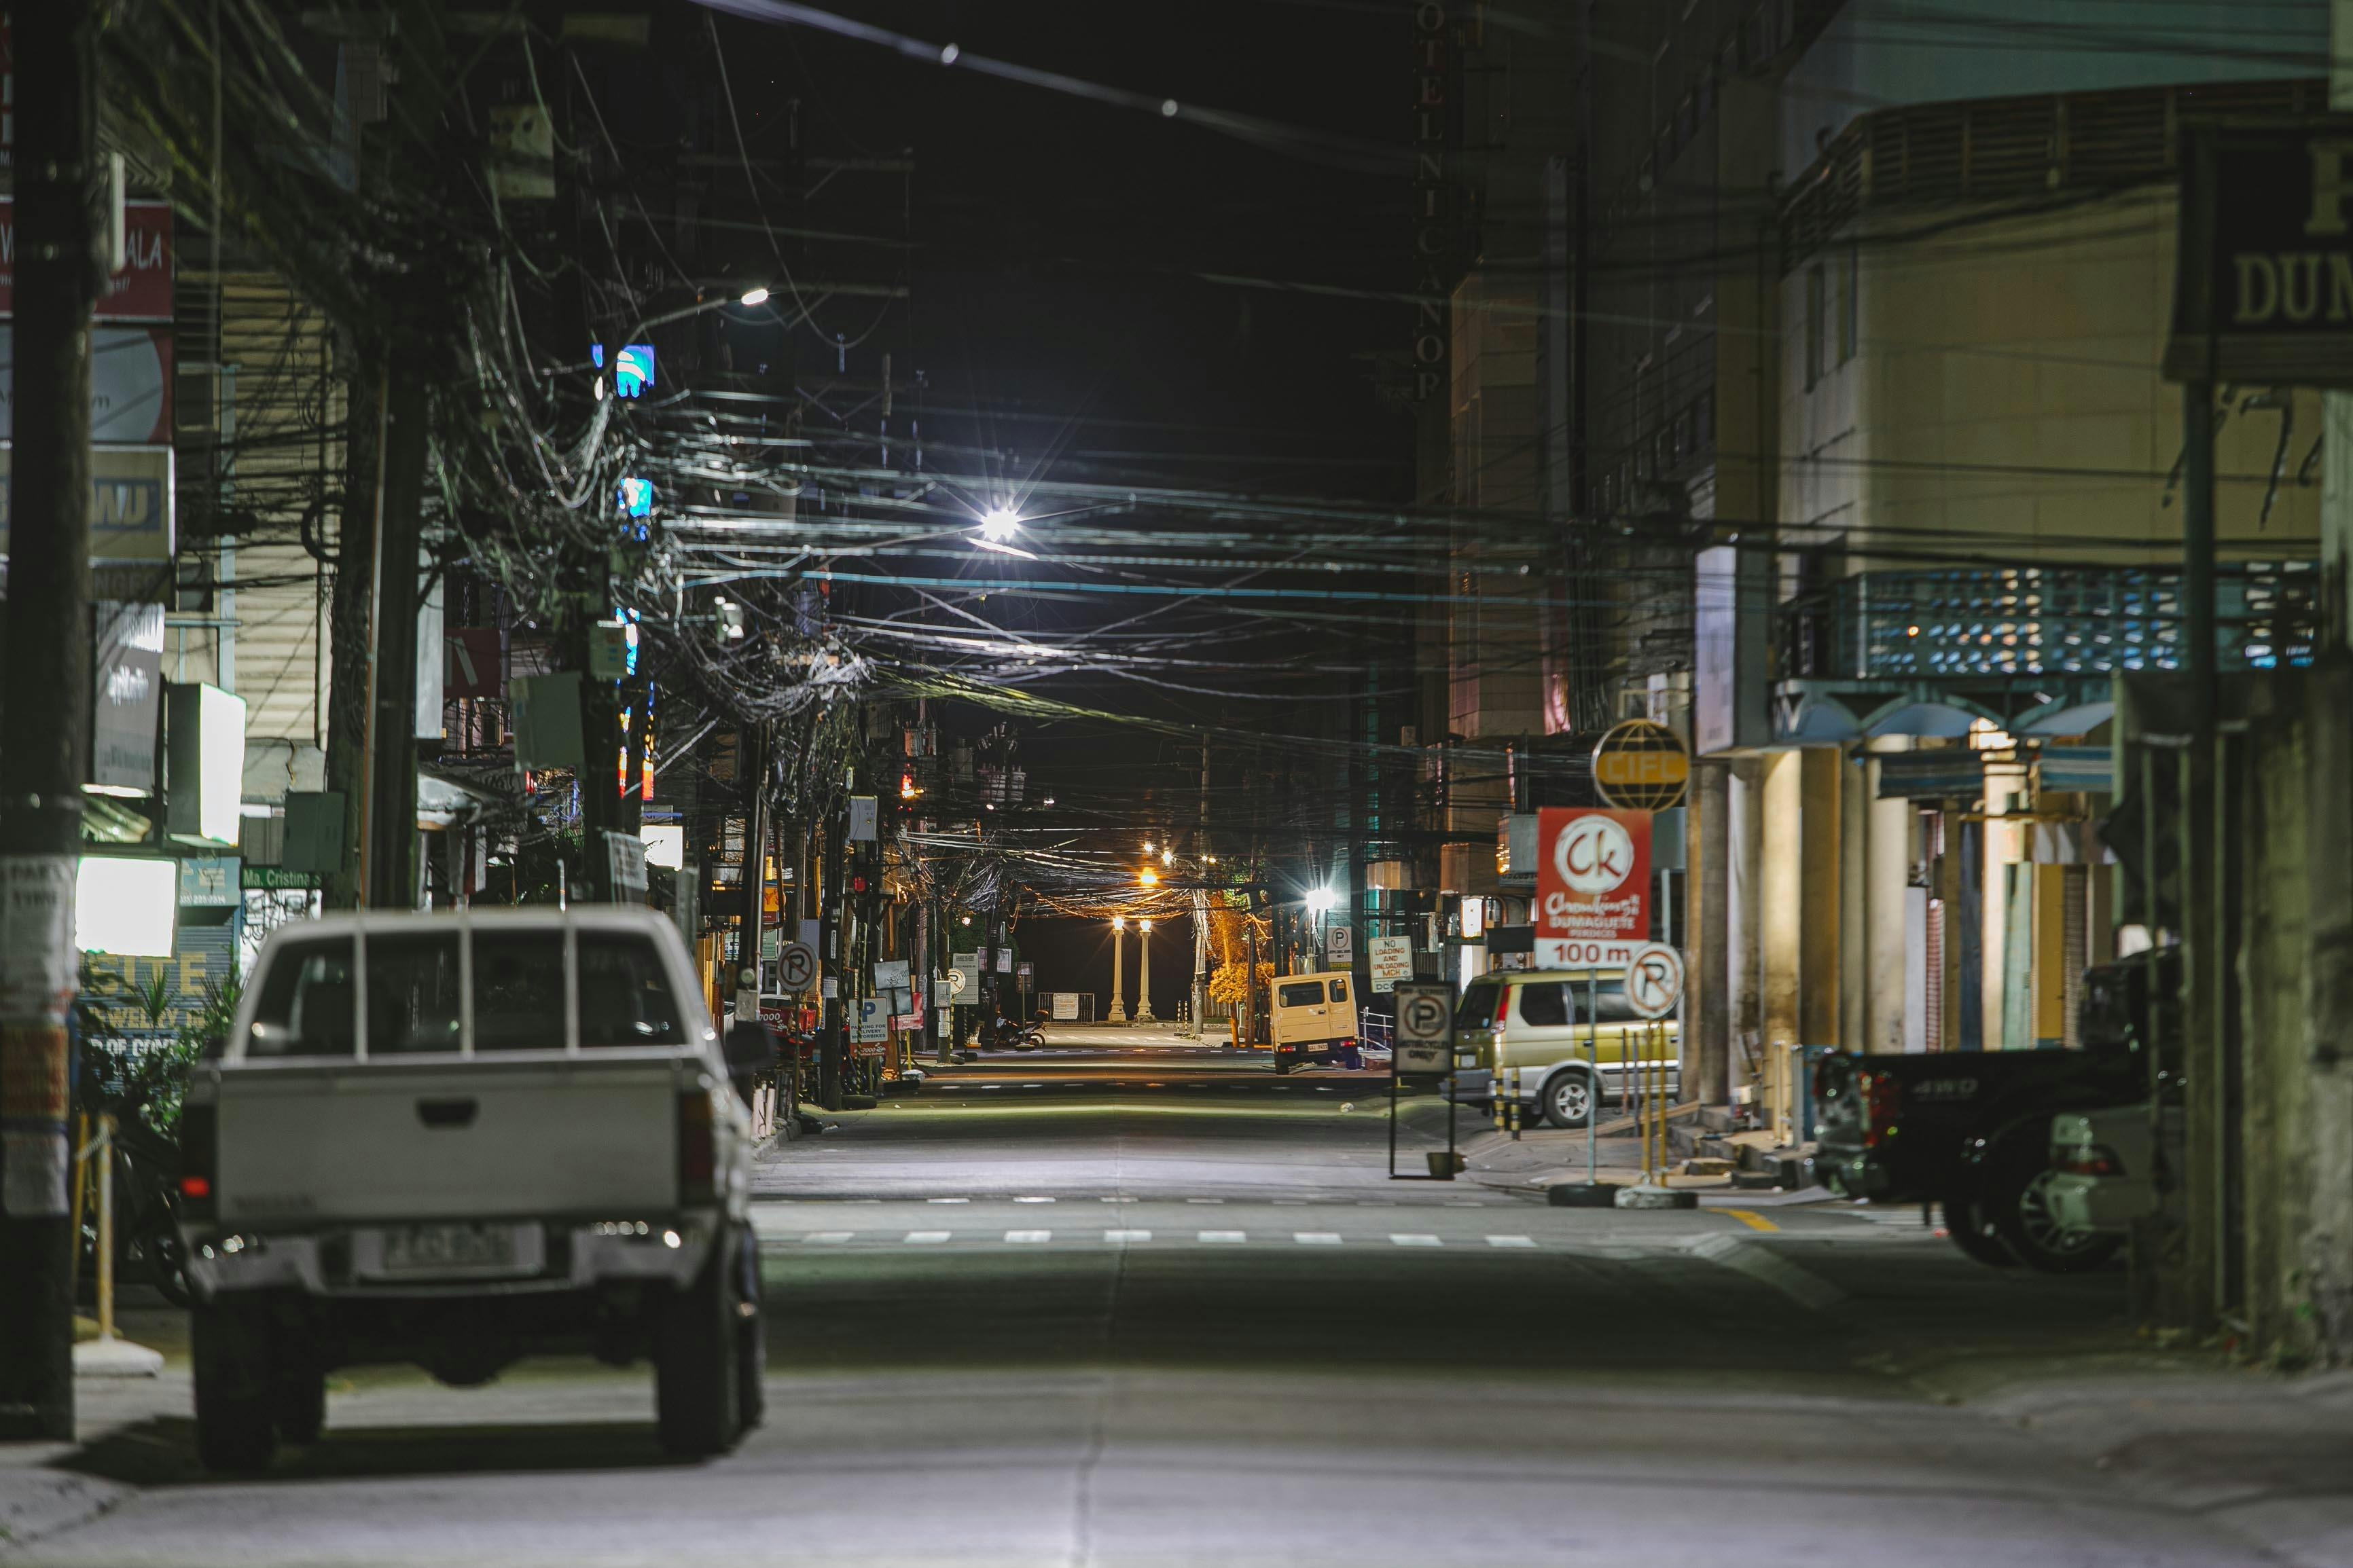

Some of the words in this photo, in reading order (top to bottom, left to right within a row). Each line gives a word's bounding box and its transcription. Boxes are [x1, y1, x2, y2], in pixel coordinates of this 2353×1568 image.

[243, 869, 263, 887] Ma.
[266, 869, 310, 888] Cristina
[1549, 915, 1636, 930] DUMAGUETE
[1384, 940, 1396, 948] NO
[1375, 947, 1405, 956] LOADING
[1553, 943, 1600, 963] 100
[1373, 962, 1409, 970] UNLOADING
